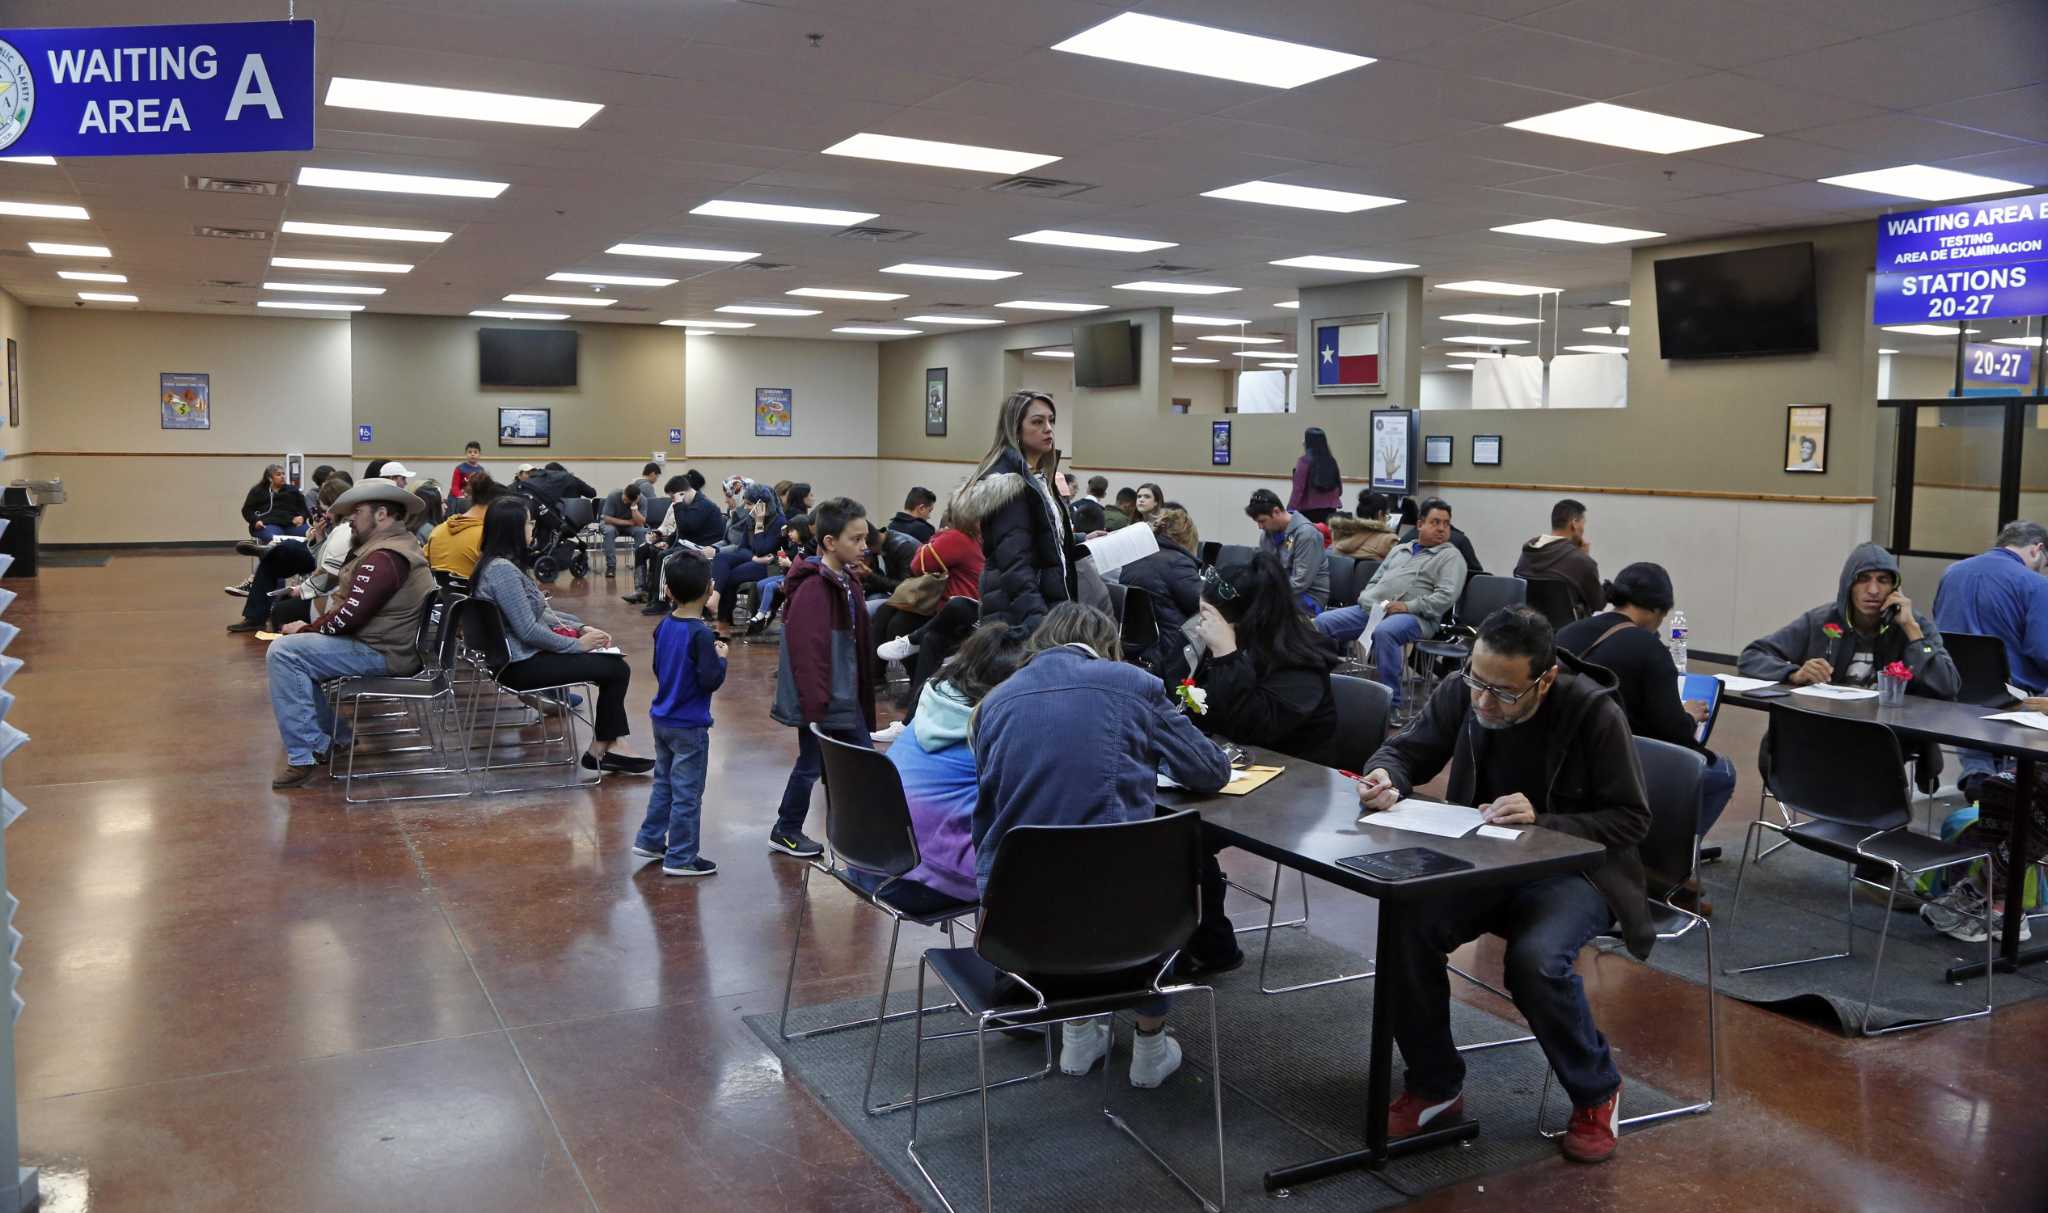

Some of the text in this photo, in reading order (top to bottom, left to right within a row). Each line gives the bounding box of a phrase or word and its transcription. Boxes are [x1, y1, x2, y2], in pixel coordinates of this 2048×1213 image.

[47, 44, 284, 121] WAITING A
[78, 98, 191, 134] AREA
[1887, 211, 1969, 236] WAITING
[1973, 203, 2034, 227] AREA
[1894, 239, 2042, 264] AREA DE EXAMINACION
[1939, 232, 1994, 248] TESTING
[1901, 267, 2027, 296] STATIONS
[1928, 294, 1994, 317] 20-27
[1973, 350, 2021, 378] 20-27
